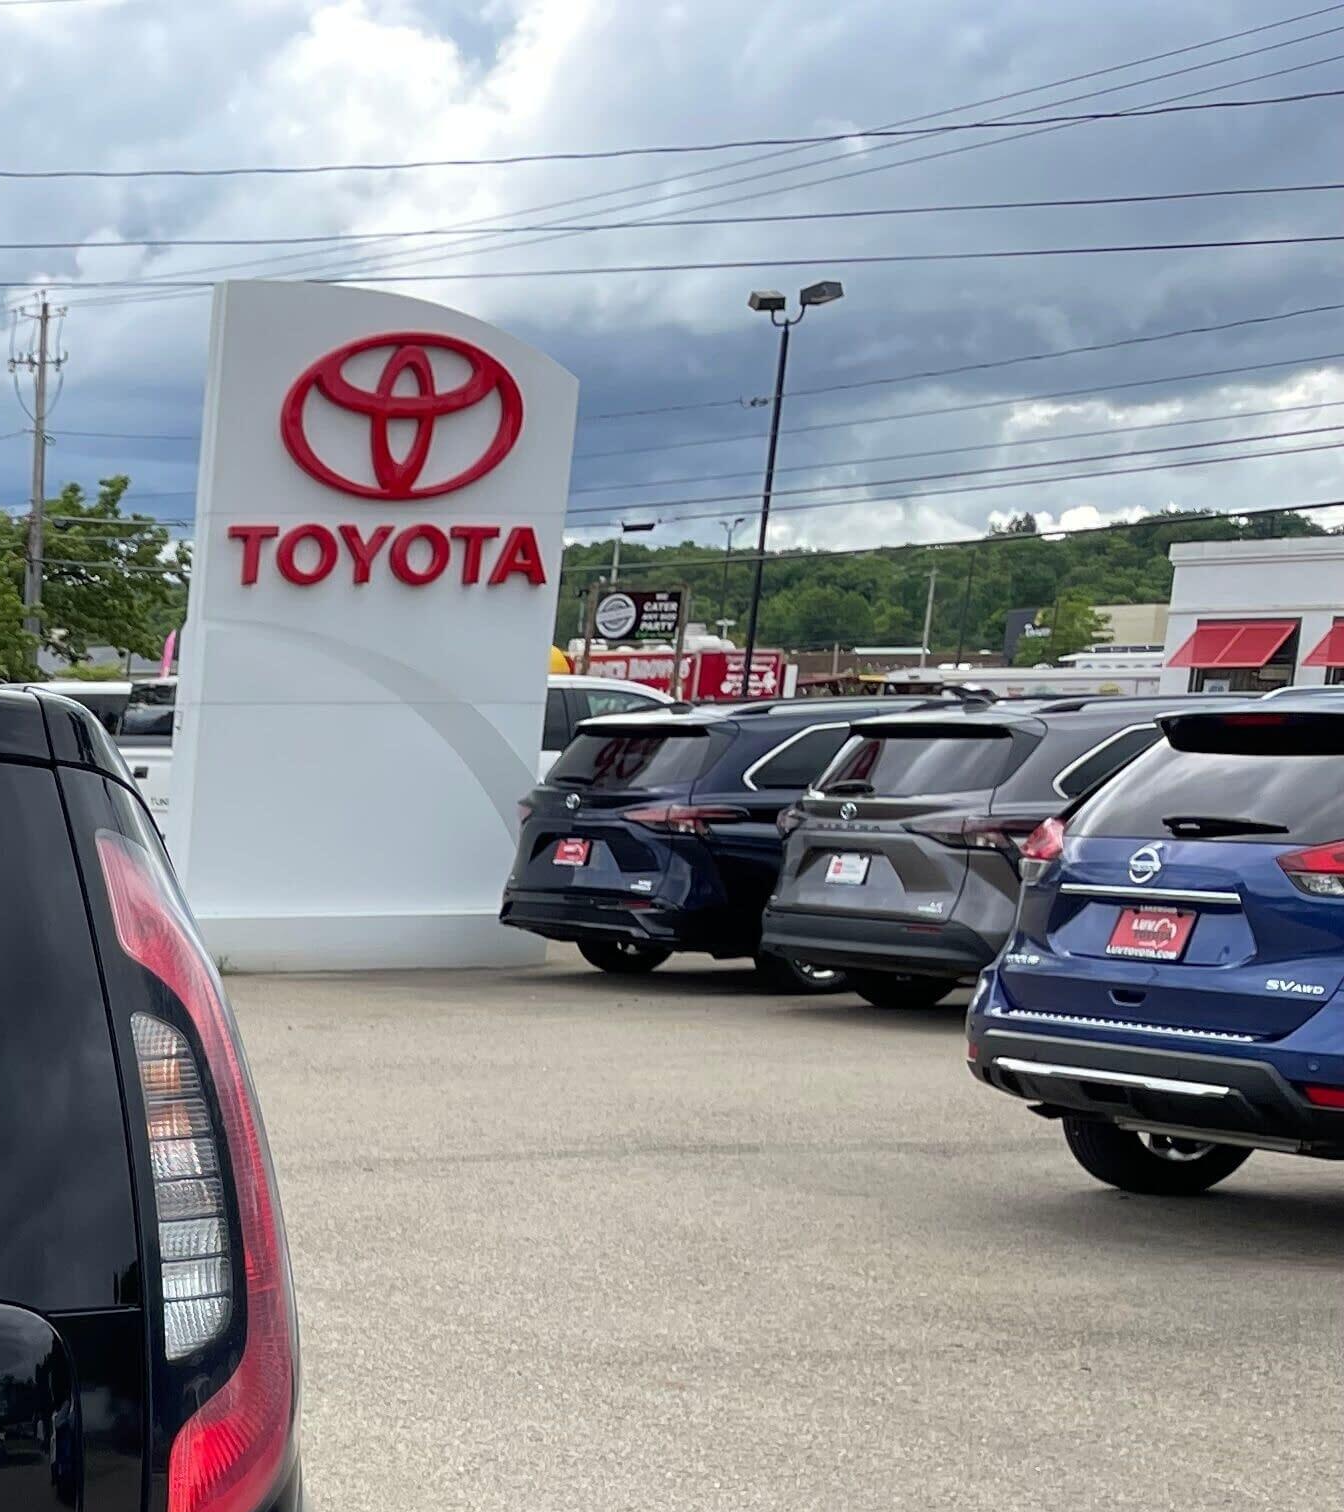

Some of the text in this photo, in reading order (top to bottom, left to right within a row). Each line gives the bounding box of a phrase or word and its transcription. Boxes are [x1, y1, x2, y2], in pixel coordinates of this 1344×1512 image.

[227, 523, 547, 588] TOYOTA
[643, 601, 679, 612] CATER
[639, 621, 675, 632] PARTY
[1131, 918, 1156, 931] LUV
[1265, 979, 1325, 995] SV AWD
